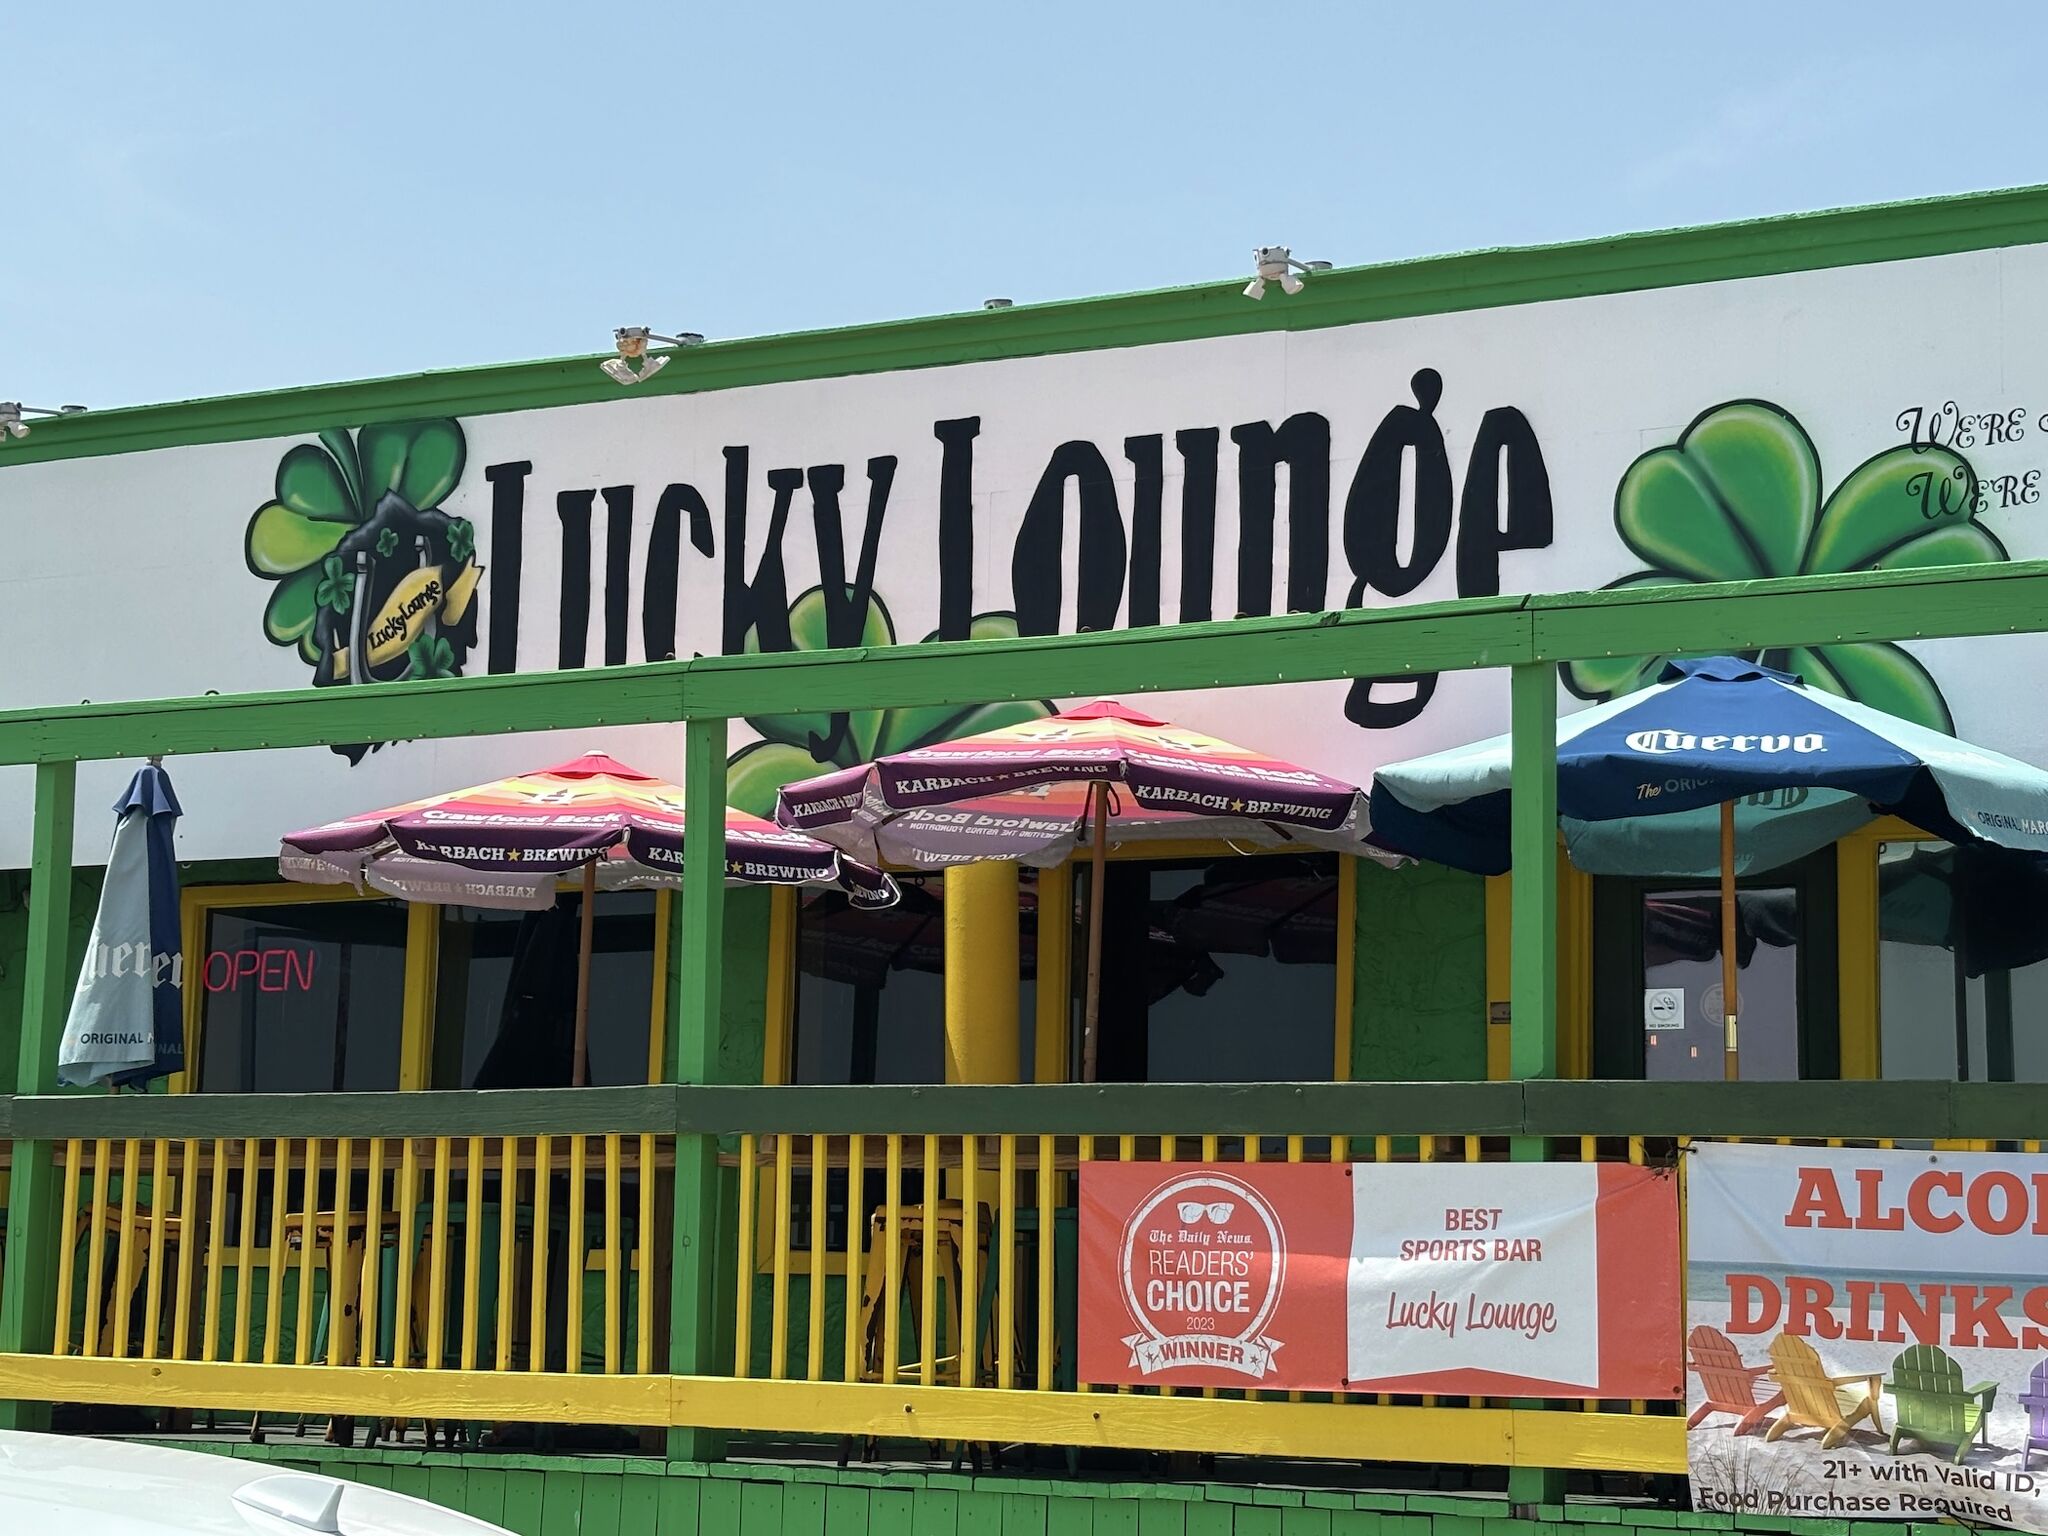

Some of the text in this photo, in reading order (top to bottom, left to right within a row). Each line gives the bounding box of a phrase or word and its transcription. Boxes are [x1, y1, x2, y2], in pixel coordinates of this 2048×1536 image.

[484, 367, 1556, 762] Lucky Lounge
[367, 580, 441, 650] Lucky Lounge
[895, 764, 1109, 795] KARBACH BREWING
[1636, 782, 1662, 800] The
[1136, 785, 1333, 820] KARBACH BREWING
[1977, 811, 2022, 832] ORIGINAL
[745, 861, 829, 879] BREWING
[203, 949, 315, 992] OPEN
[80, 1032, 144, 1045] ORIGINAL
[1445, 1208, 1503, 1231] BEST
[1149, 1229, 1173, 1245] The
[1178, 1229, 1210, 1246] Daily
[1400, 1239, 1543, 1262] SPORTS BAR
[1146, 1279, 1250, 1313] CHOICE
[1186, 1316, 1215, 1331] 2023
[1385, 1290, 1557, 1340] Lucky Lounge
[1159, 1341, 1245, 1364] WINNER
[1823, 1460, 2041, 1498] 21+ with Valid ID,
[1700, 1487, 2014, 1522] Food Purchase Required
